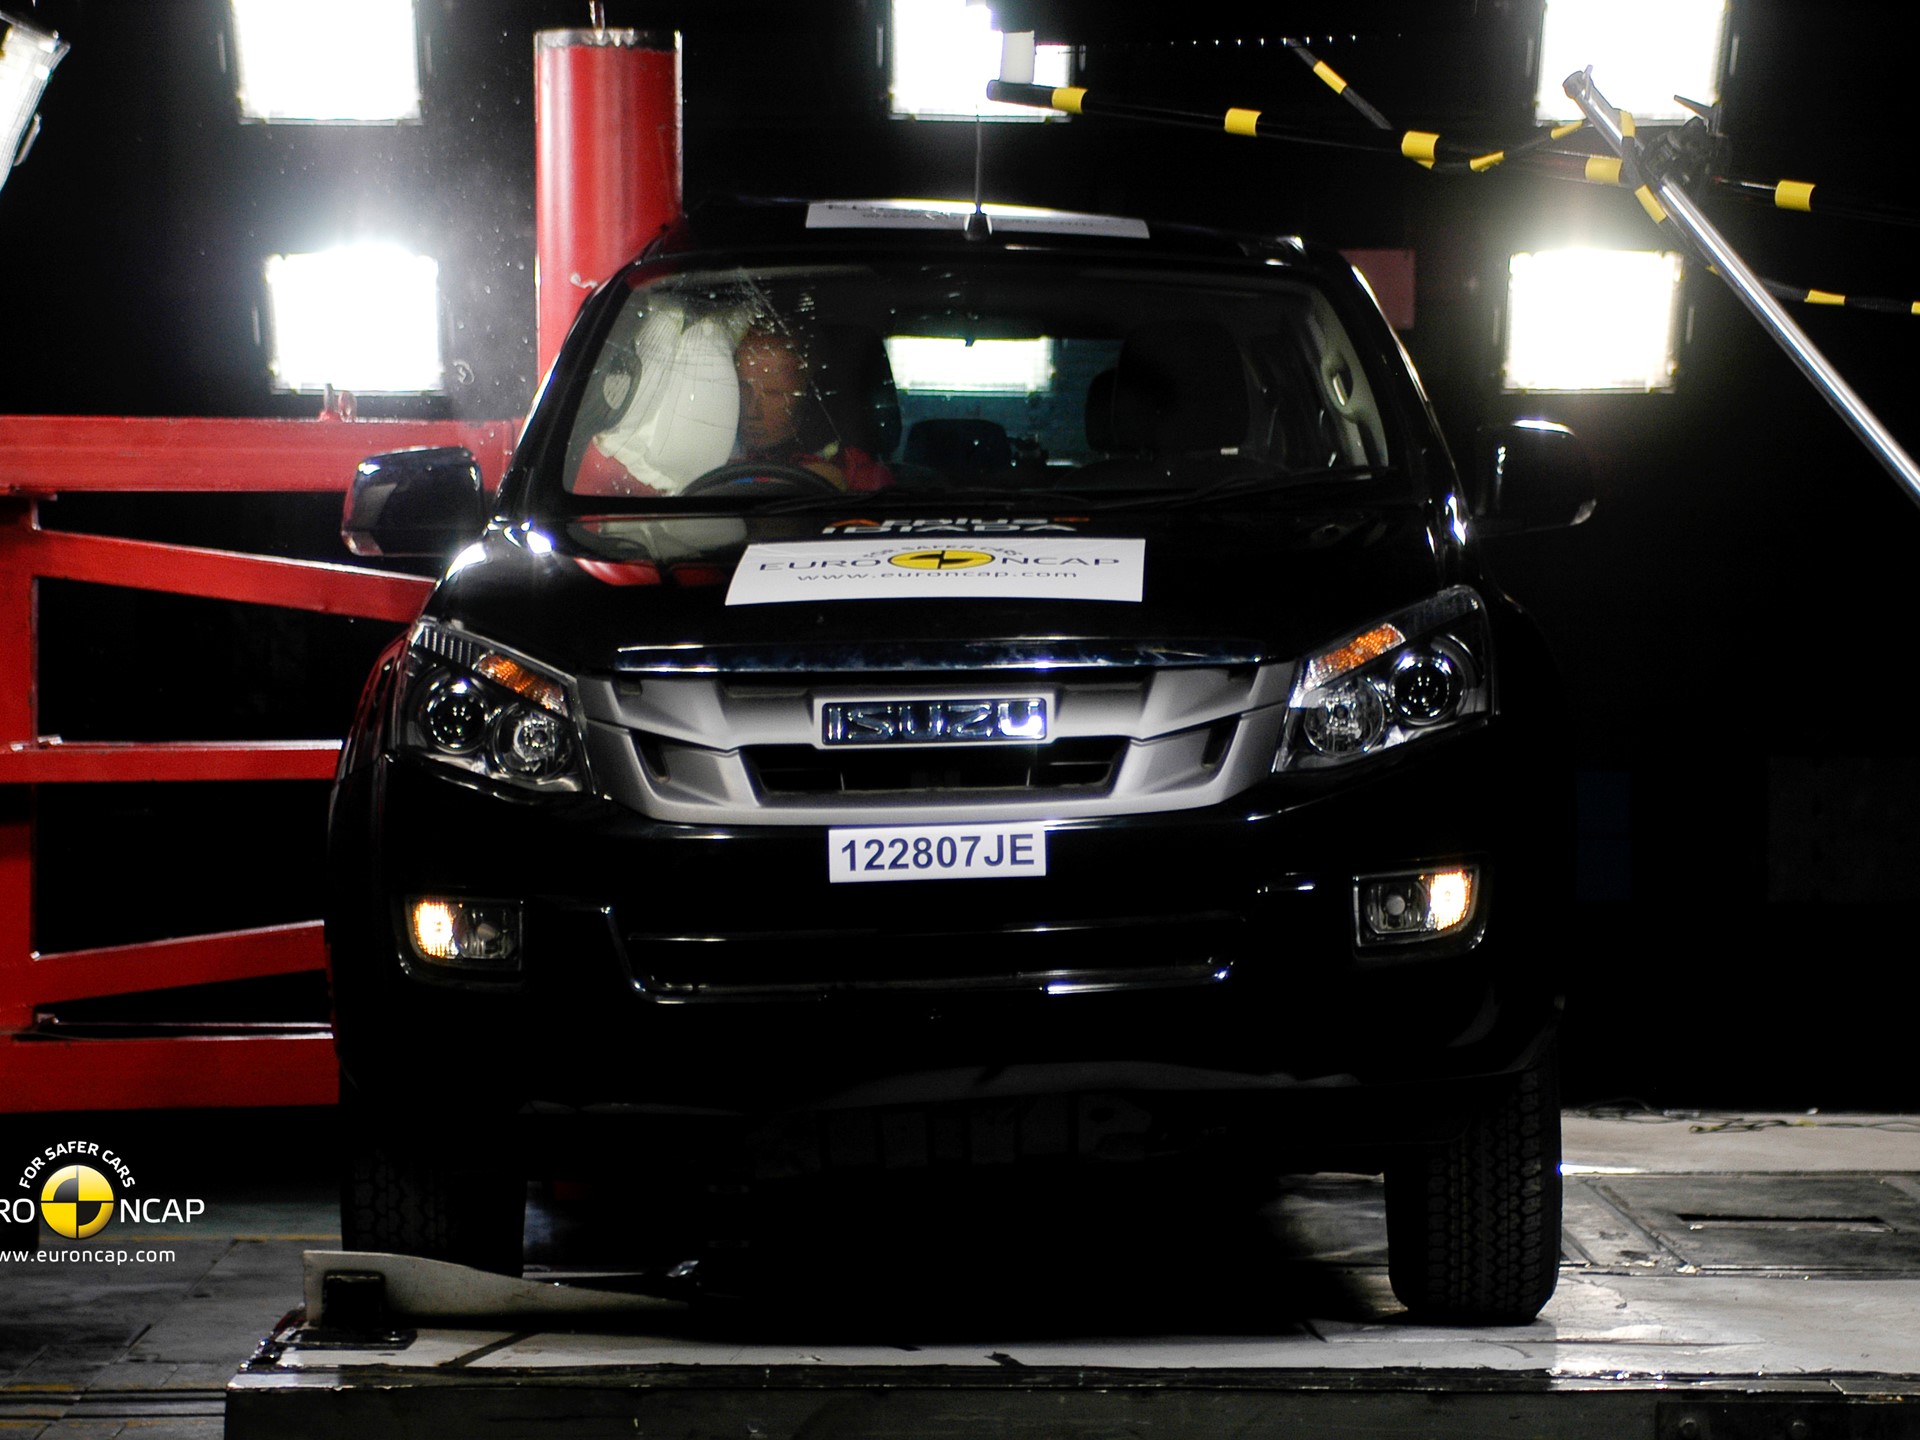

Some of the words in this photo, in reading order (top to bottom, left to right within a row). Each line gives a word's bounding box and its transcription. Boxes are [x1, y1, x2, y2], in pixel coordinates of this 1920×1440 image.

[759, 558, 882, 571] EURO
[1001, 557, 1120, 567] NCAP
[798, 571, 1078, 582] www.euroncap.com
[827, 698, 1046, 741] ISUZU
[841, 834, 1035, 872] 122807JE
